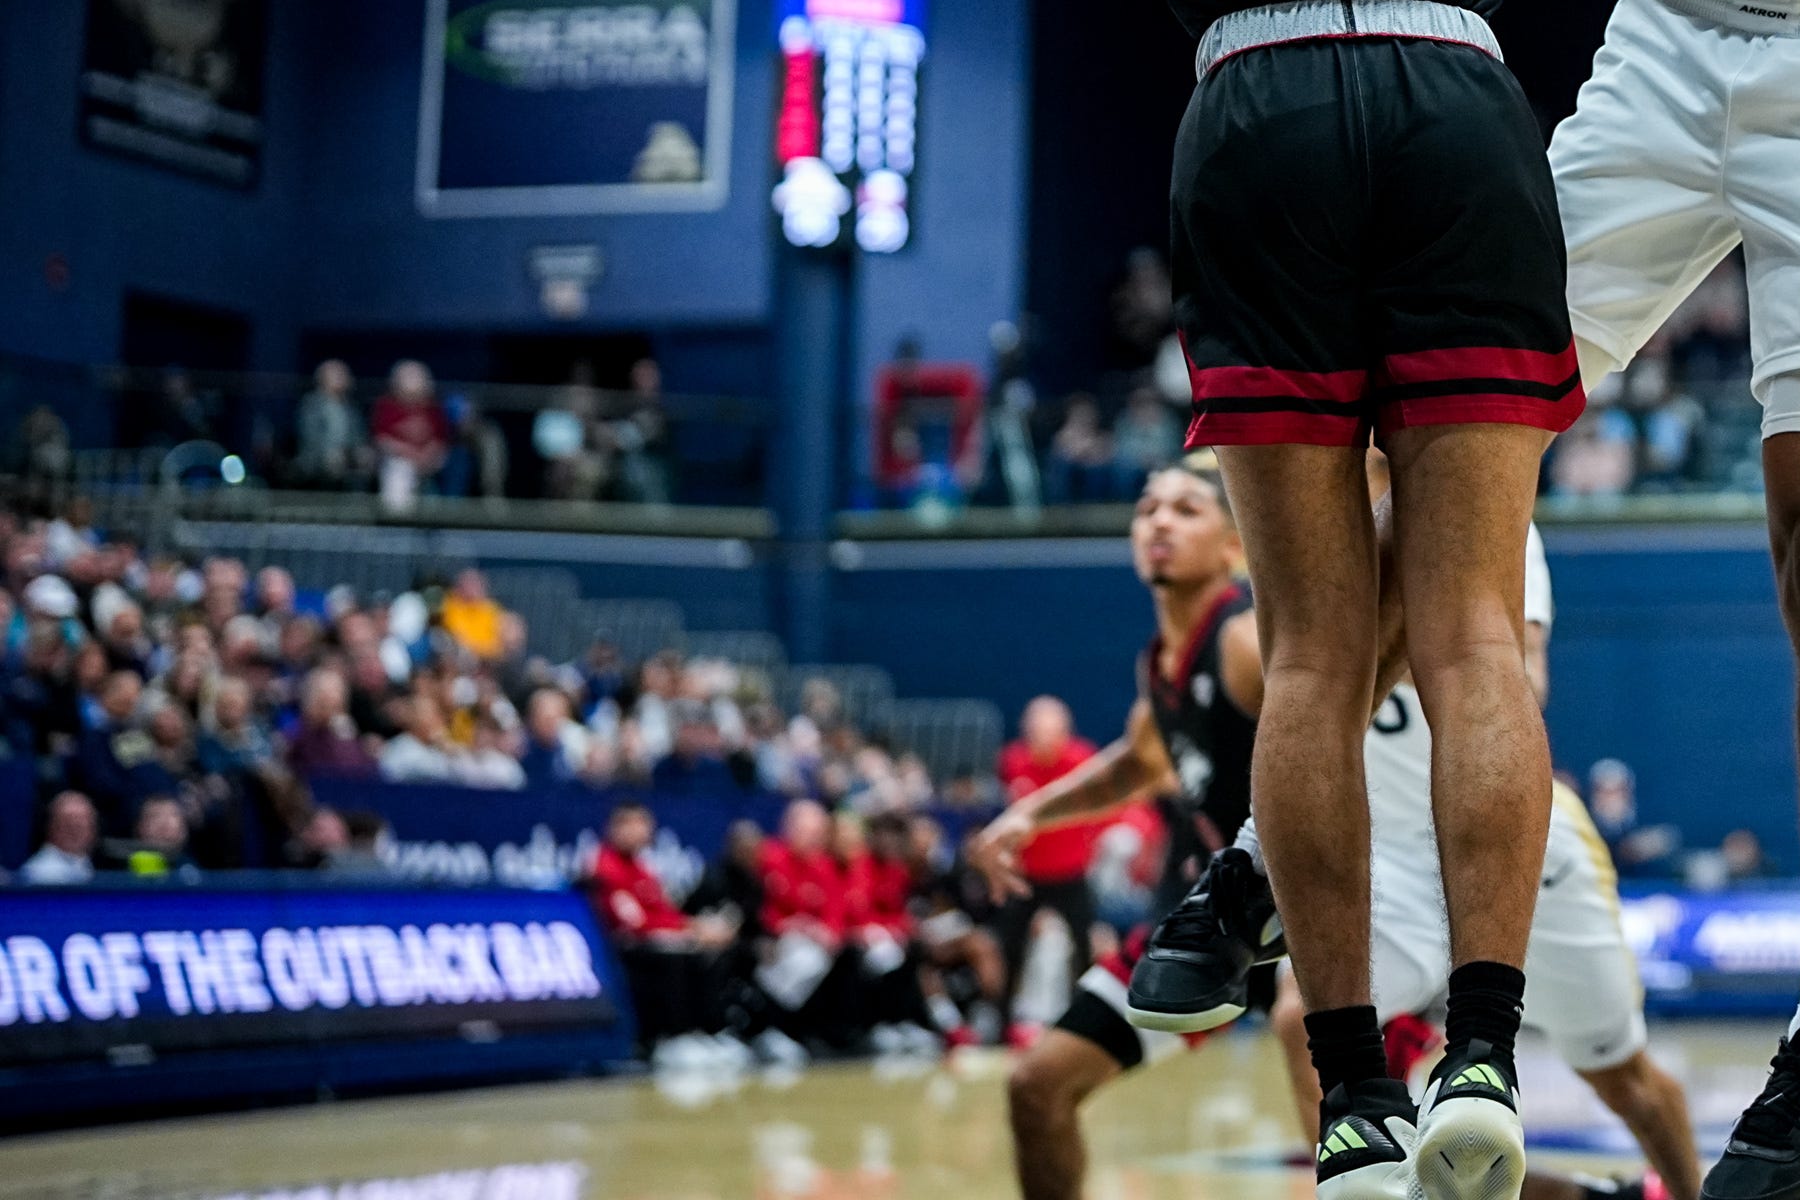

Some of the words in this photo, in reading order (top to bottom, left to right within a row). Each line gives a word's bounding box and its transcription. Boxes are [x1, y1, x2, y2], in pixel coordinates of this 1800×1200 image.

[1739, 4, 1788, 20] AKRON
[62, 931, 151, 1021] OF
[144, 927, 273, 1016] THE
[262, 924, 501, 1011] OUTBACK
[492, 920, 601, 1001] BAR
